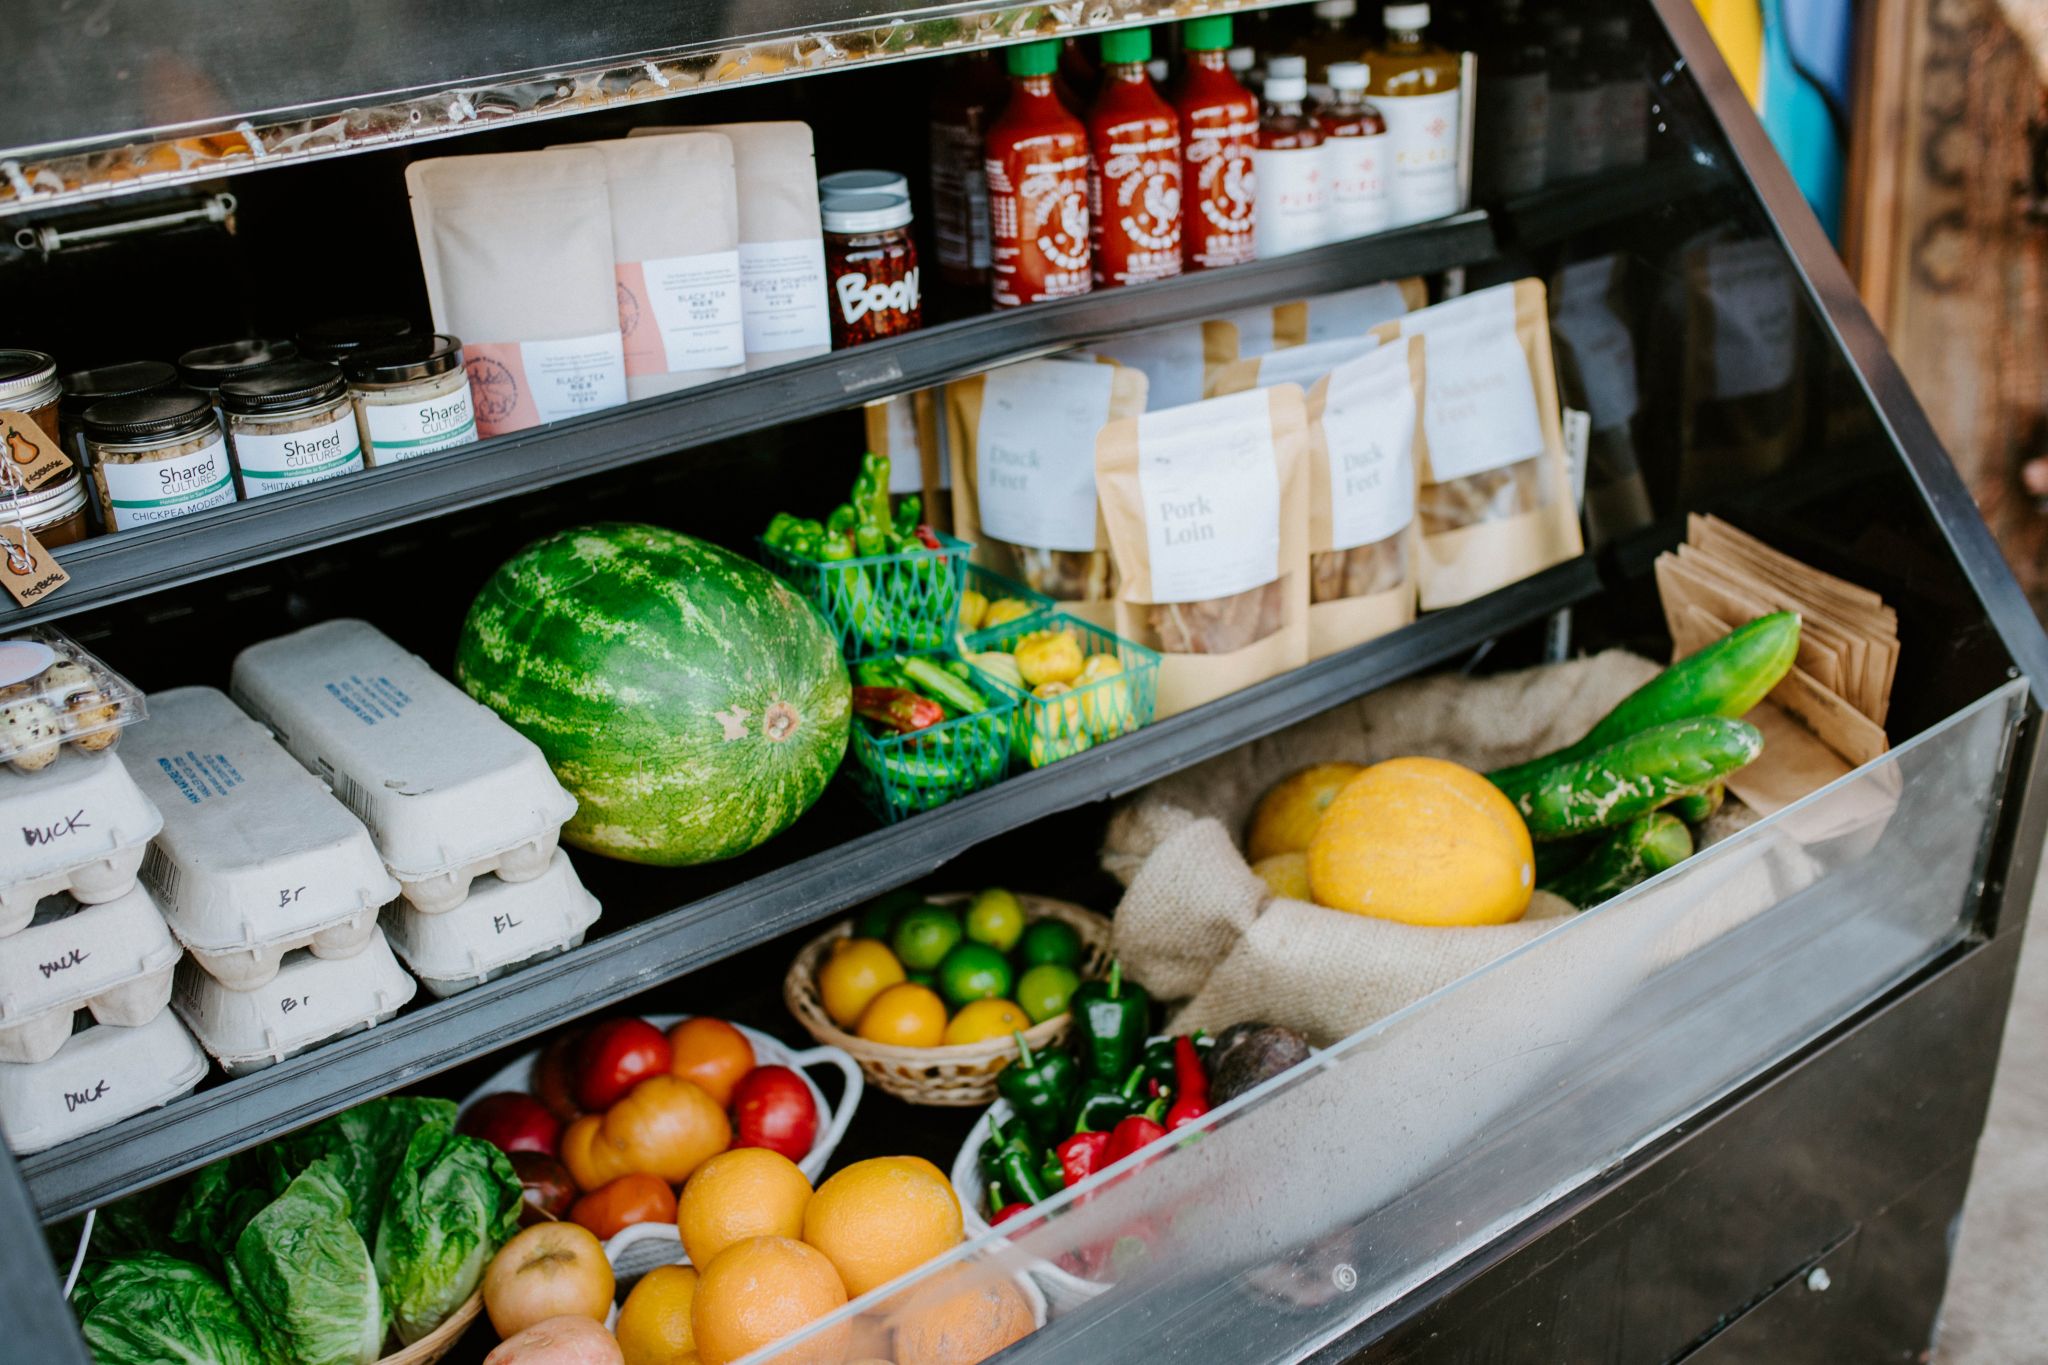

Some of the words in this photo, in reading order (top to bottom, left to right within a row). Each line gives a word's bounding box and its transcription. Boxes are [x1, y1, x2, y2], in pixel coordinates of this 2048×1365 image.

[678, 292, 706, 303] BLACK
[709, 290, 725, 299] TEA
[556, 376, 585, 386] BLACK
[588, 374, 605, 383] TEA
[420, 395, 466, 424] Shared
[421, 412, 469, 435] CULTURES
[284, 430, 340, 457] Shared
[286, 445, 342, 468] CULTURES
[159, 454, 215, 485] Shared
[162, 470, 218, 496] CULTURES
[132, 505, 185, 521] CHICKPEA
[187, 493, 225, 513] MODERN
[1160, 494, 1213, 522] Pork
[1164, 521, 1215, 547] Loin
